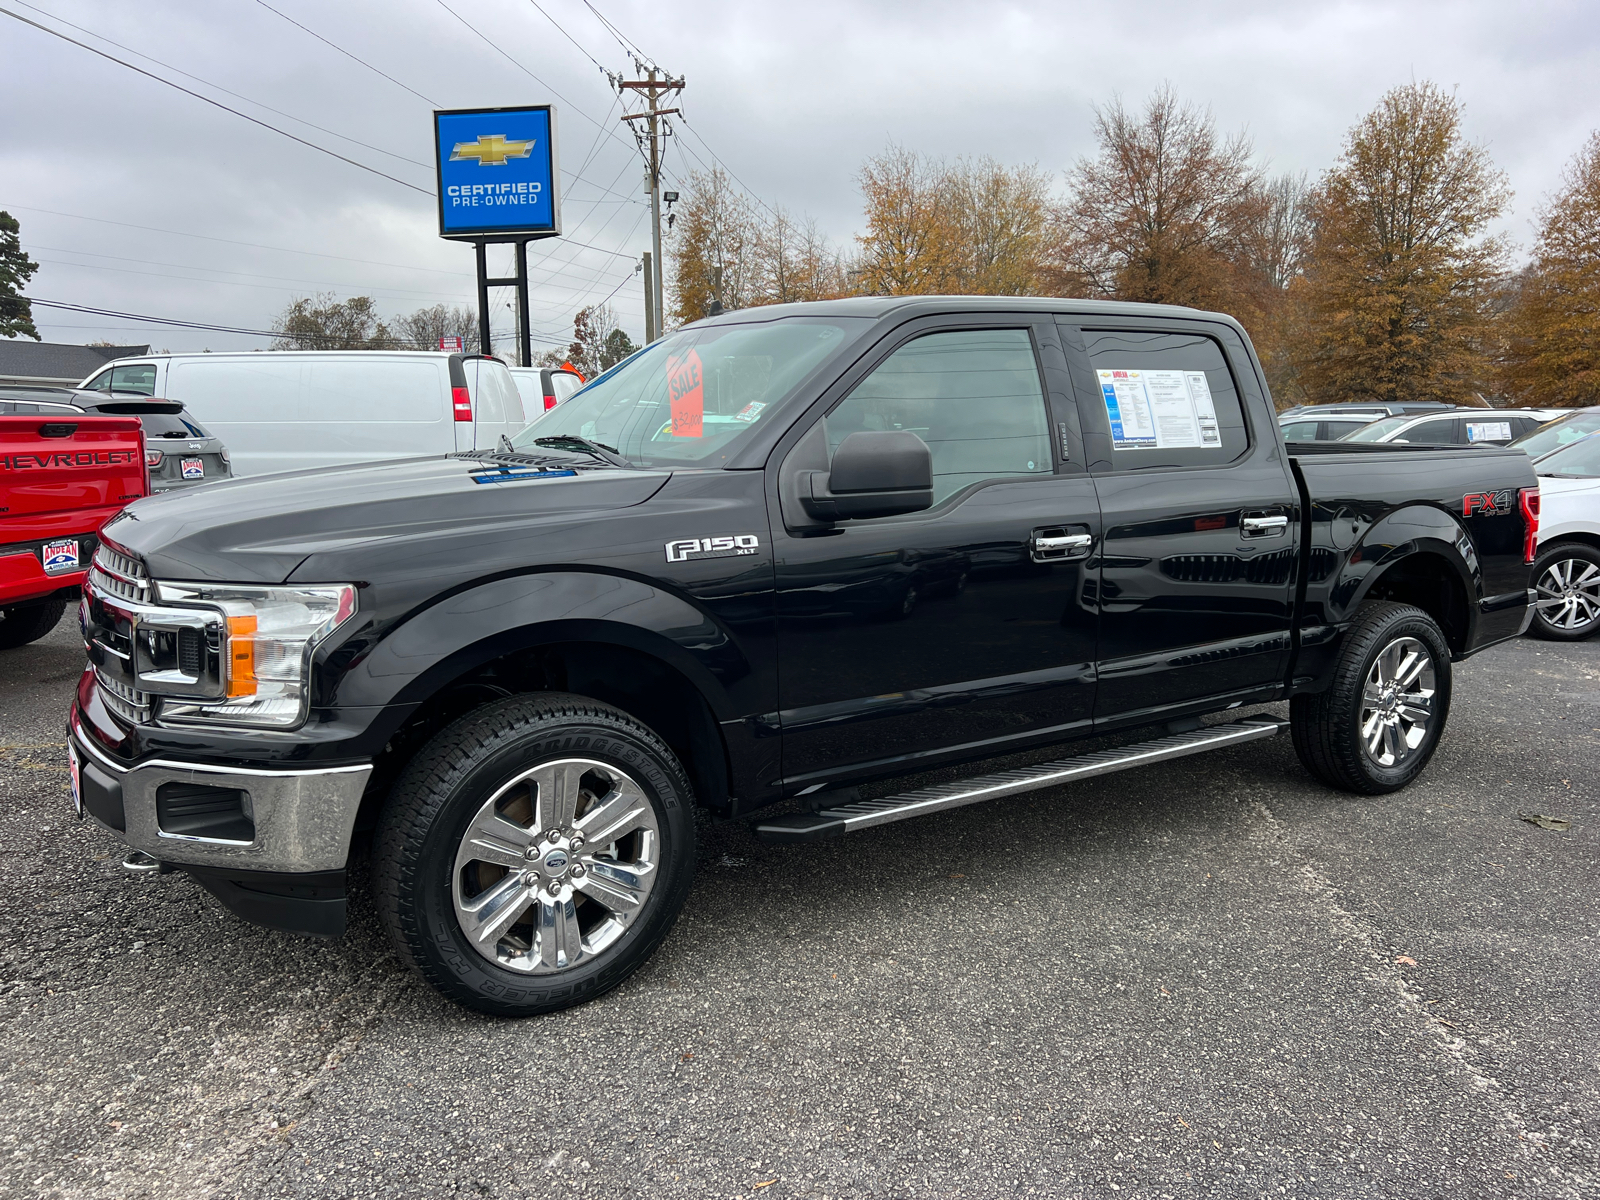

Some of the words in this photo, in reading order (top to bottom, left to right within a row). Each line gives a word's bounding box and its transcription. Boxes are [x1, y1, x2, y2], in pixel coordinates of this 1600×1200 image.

[447, 182, 542, 197] CERTIFIED
[452, 194, 538, 208] PRE-OWNED
[670, 364, 700, 401] SALE
[188, 442, 202, 450] Jeep
[183, 461, 203, 472] ANDEAN
[1462, 490, 1512, 518] FX4
[44, 543, 78, 563] ANDEAN
[522, 735, 679, 810] BRIDGESTONE
[478, 962, 618, 1004] DUELER
